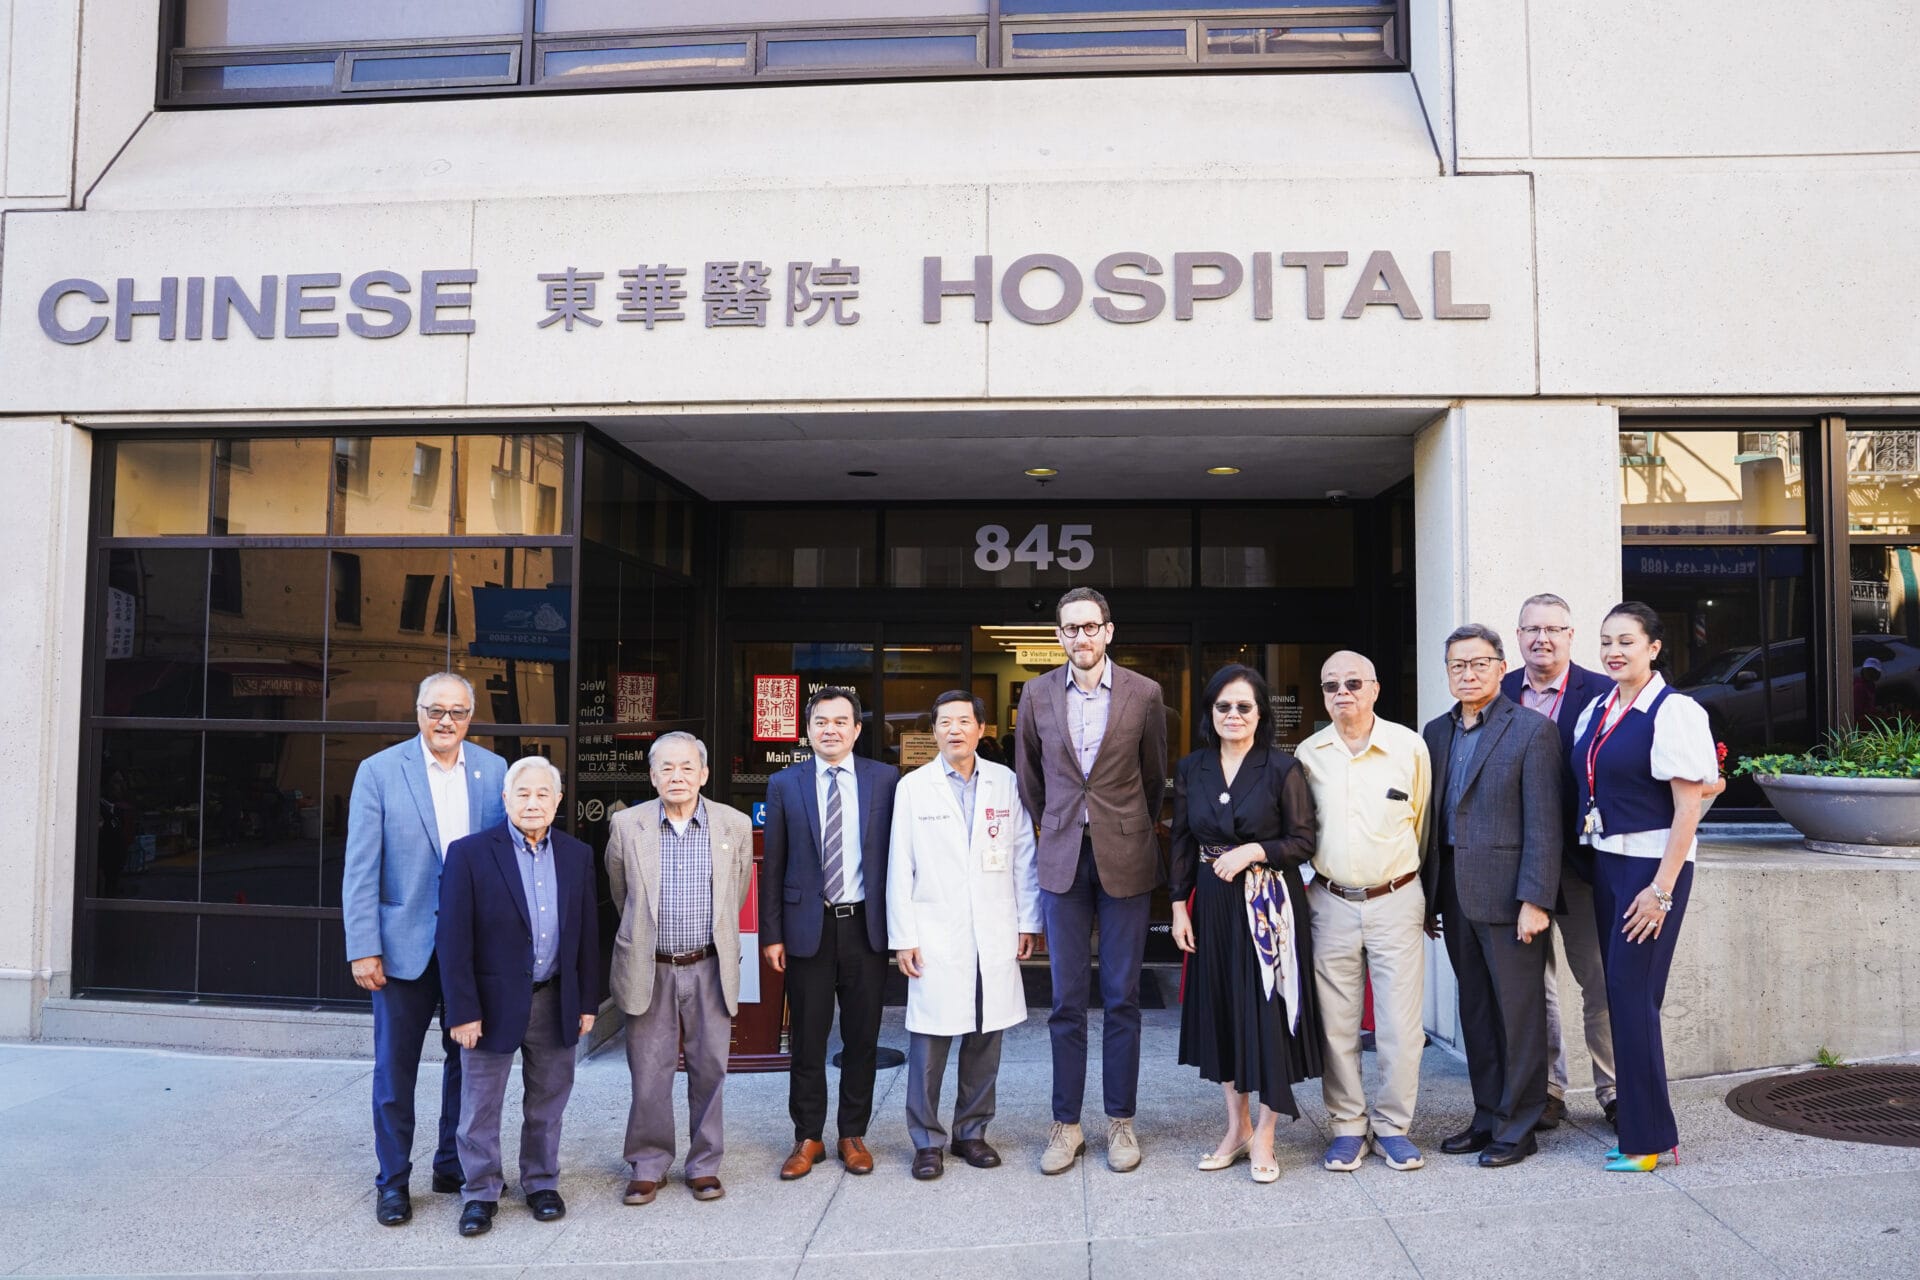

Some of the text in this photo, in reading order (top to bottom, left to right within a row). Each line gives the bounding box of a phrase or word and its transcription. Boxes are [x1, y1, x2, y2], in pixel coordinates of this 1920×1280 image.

[38, 250, 1491, 346] CHINESE 東華醫院 HOSPITAL
[974, 524, 1095, 571] 845
[766, 751, 791, 763] Main
